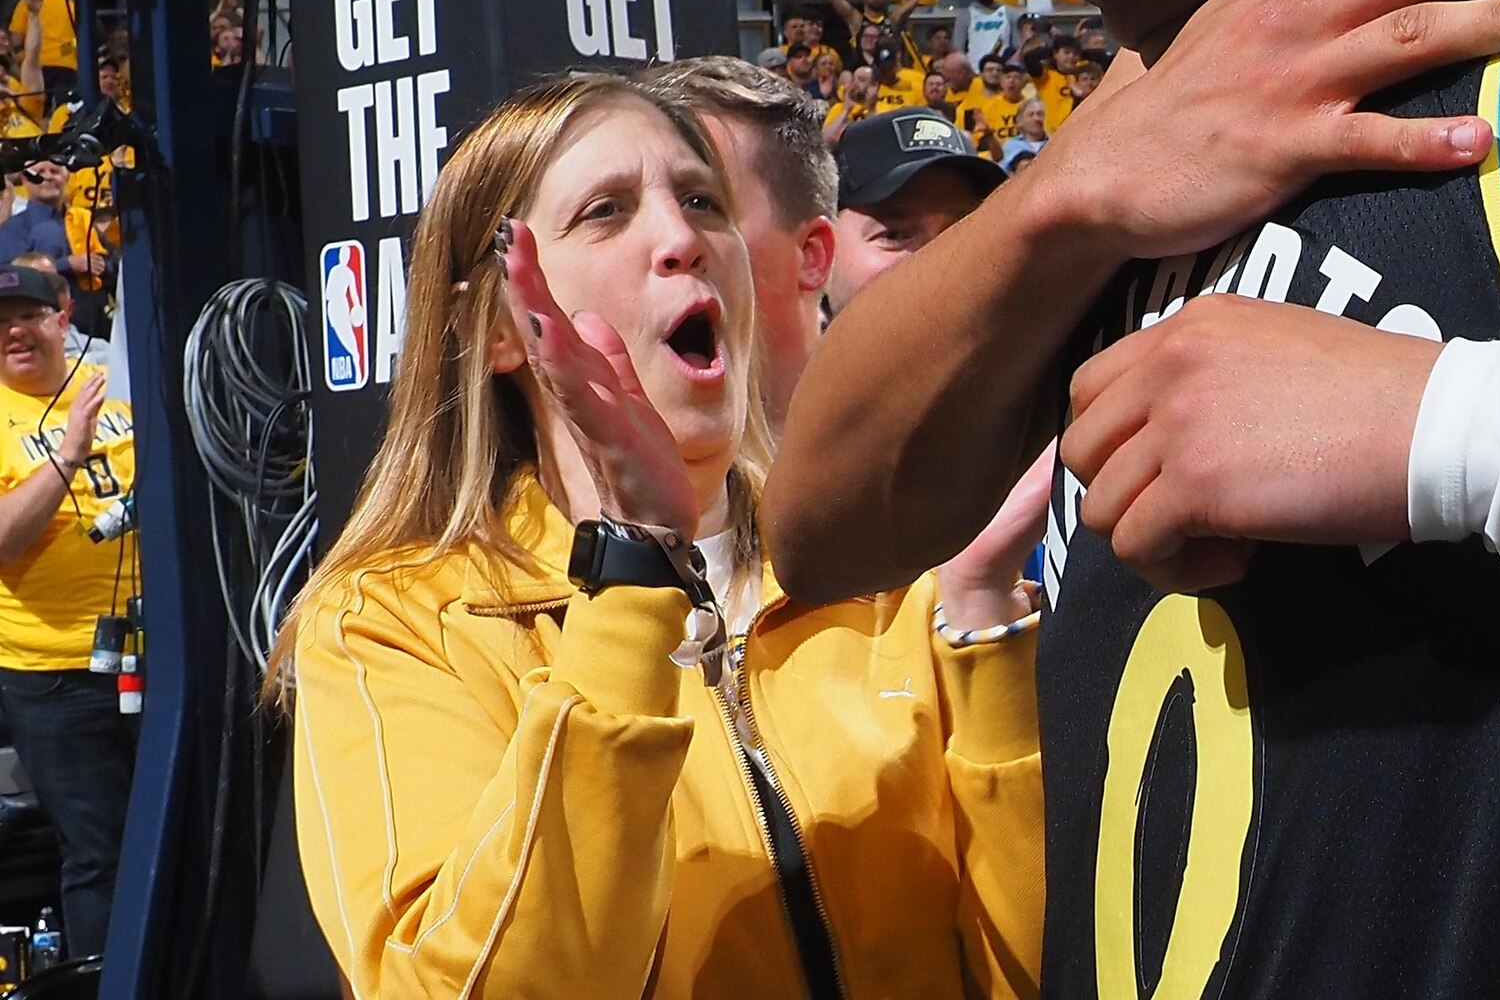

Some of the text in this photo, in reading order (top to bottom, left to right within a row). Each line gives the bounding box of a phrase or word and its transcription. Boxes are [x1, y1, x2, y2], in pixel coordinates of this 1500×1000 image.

[337, 70, 450, 222] THE
[331, 356, 353, 380] NBA
[1096, 594, 1253, 1000] 0
